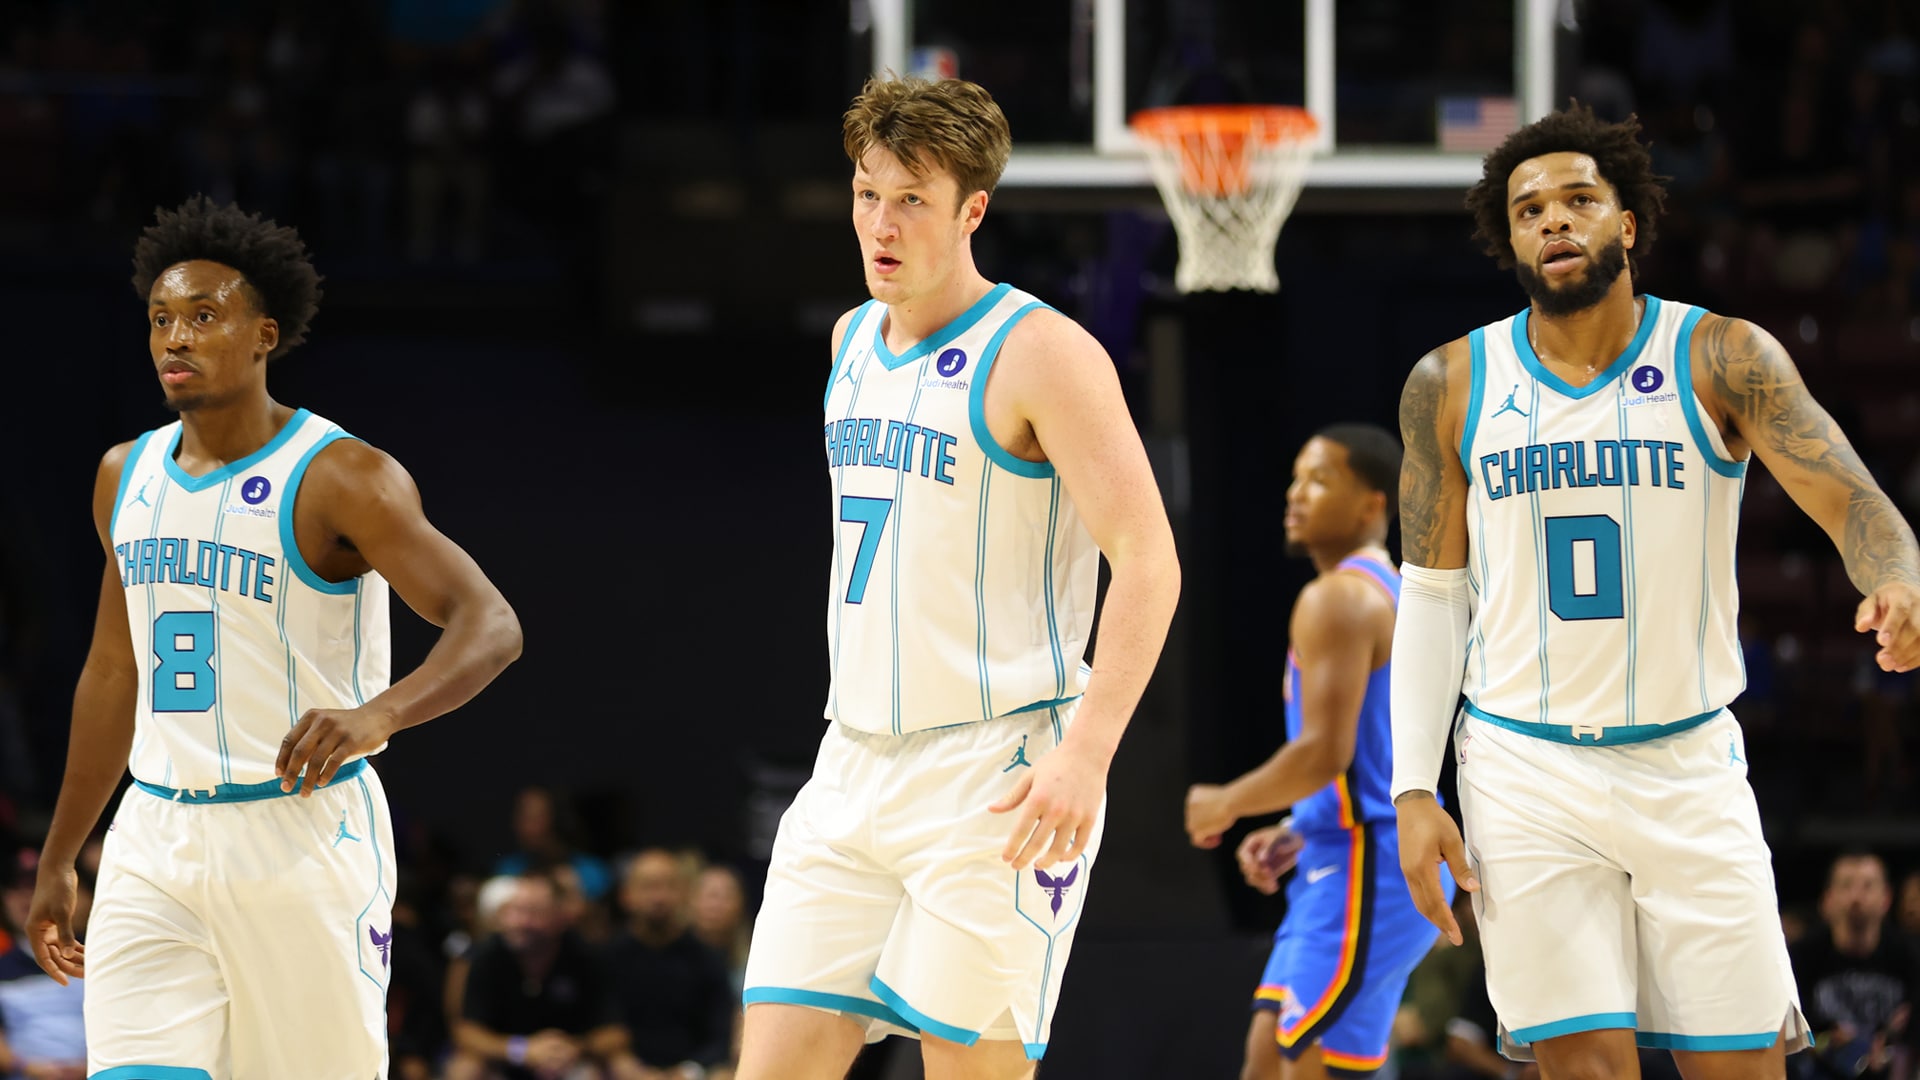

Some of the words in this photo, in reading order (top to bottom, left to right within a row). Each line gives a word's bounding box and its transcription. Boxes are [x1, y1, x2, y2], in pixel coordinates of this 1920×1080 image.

[940, 379, 969, 391] Health
[1621, 395, 1645, 407] Judi
[1646, 392, 1678, 403] Health
[1480, 439, 1685, 501] CHARLOTTE
[840, 495, 894, 605] 7
[1545, 514, 1624, 621] 0
[152, 611, 216, 713] 8
